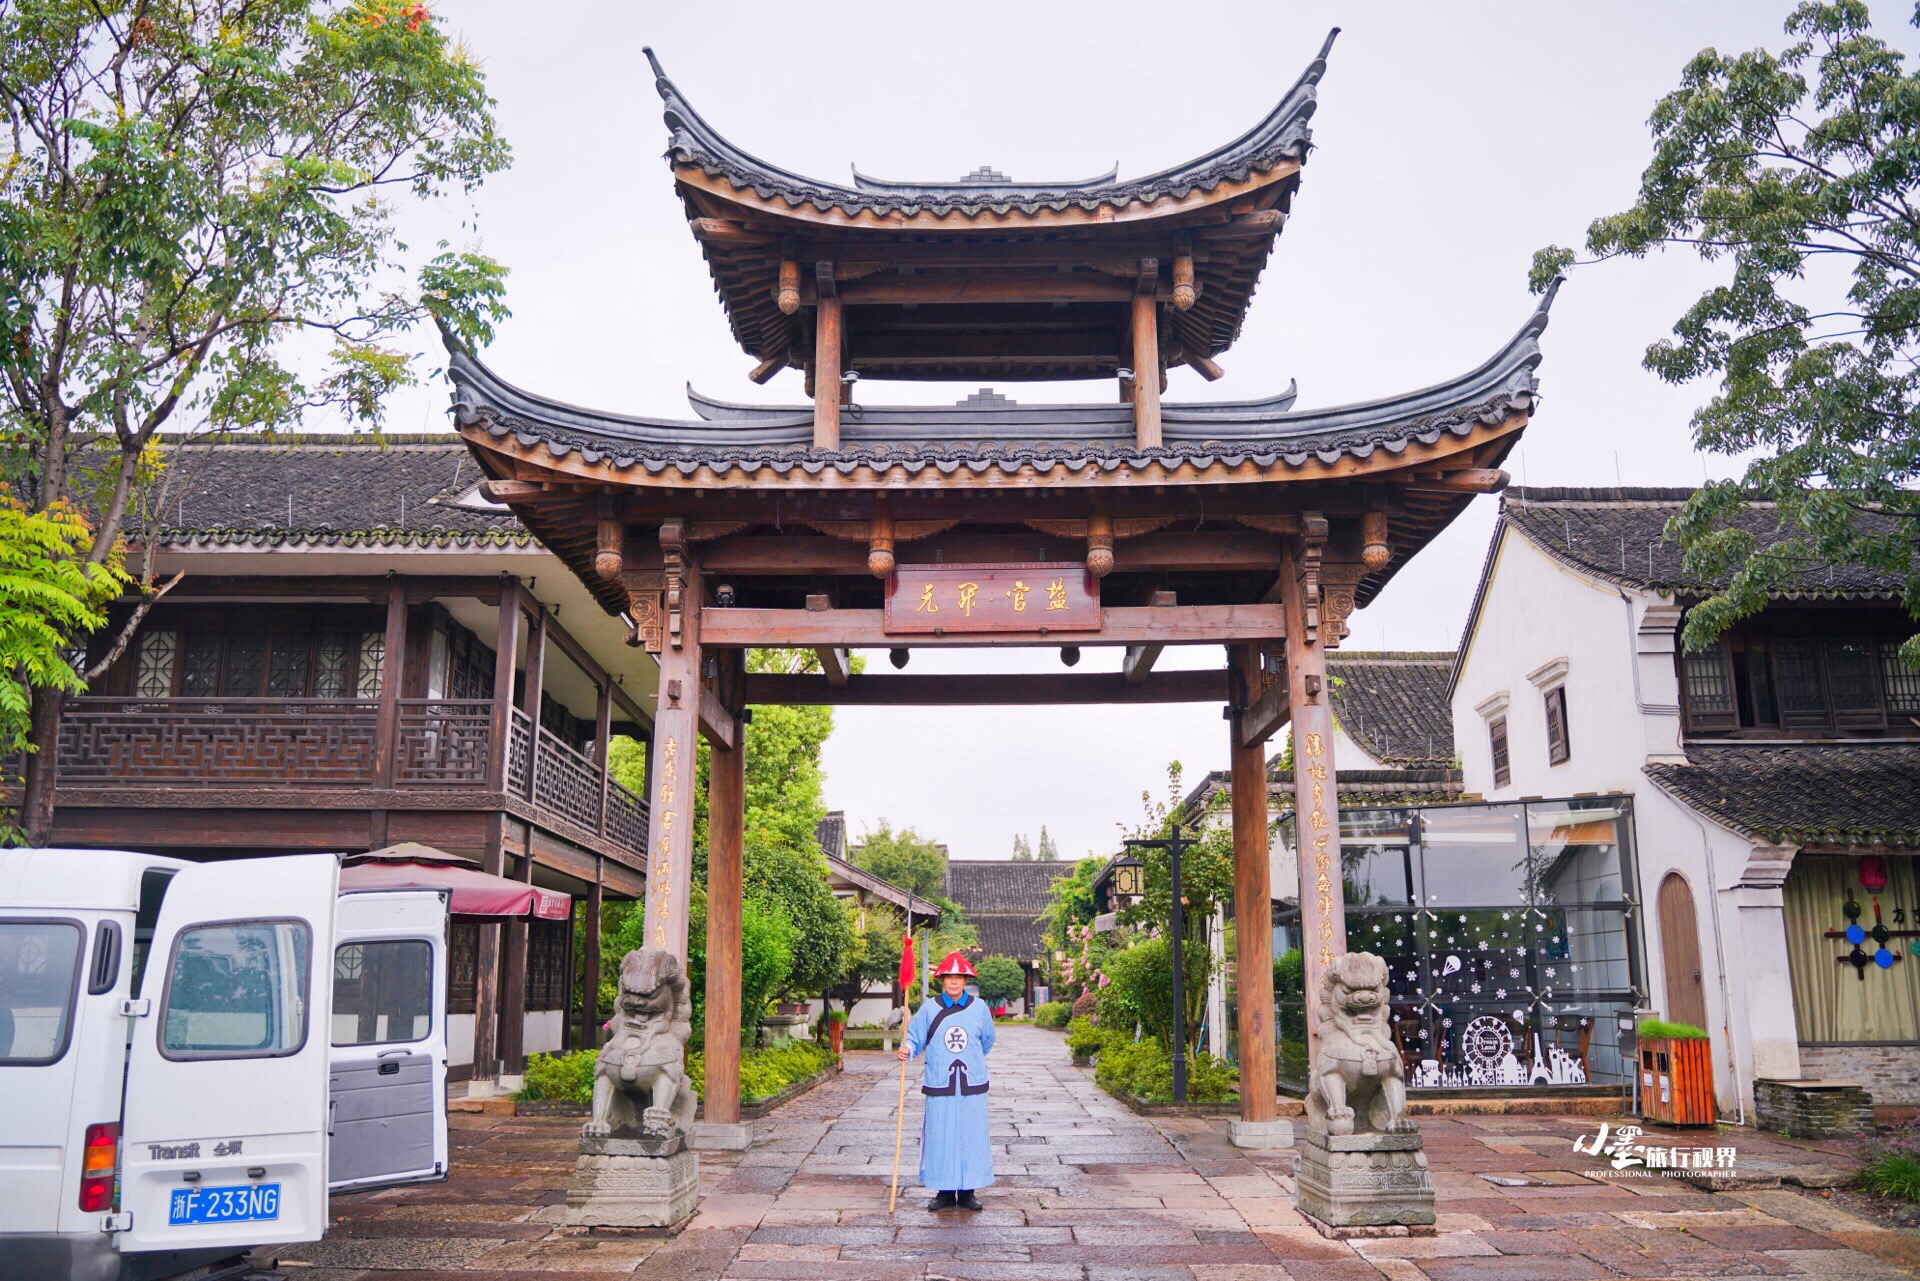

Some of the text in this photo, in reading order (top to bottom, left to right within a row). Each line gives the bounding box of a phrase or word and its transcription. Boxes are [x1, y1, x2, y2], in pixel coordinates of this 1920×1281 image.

[947, 1028, 965, 1050] 兵
[1475, 1036, 1498, 1045] Dream
[148, 1140, 243, 1160] Transit 全顺
